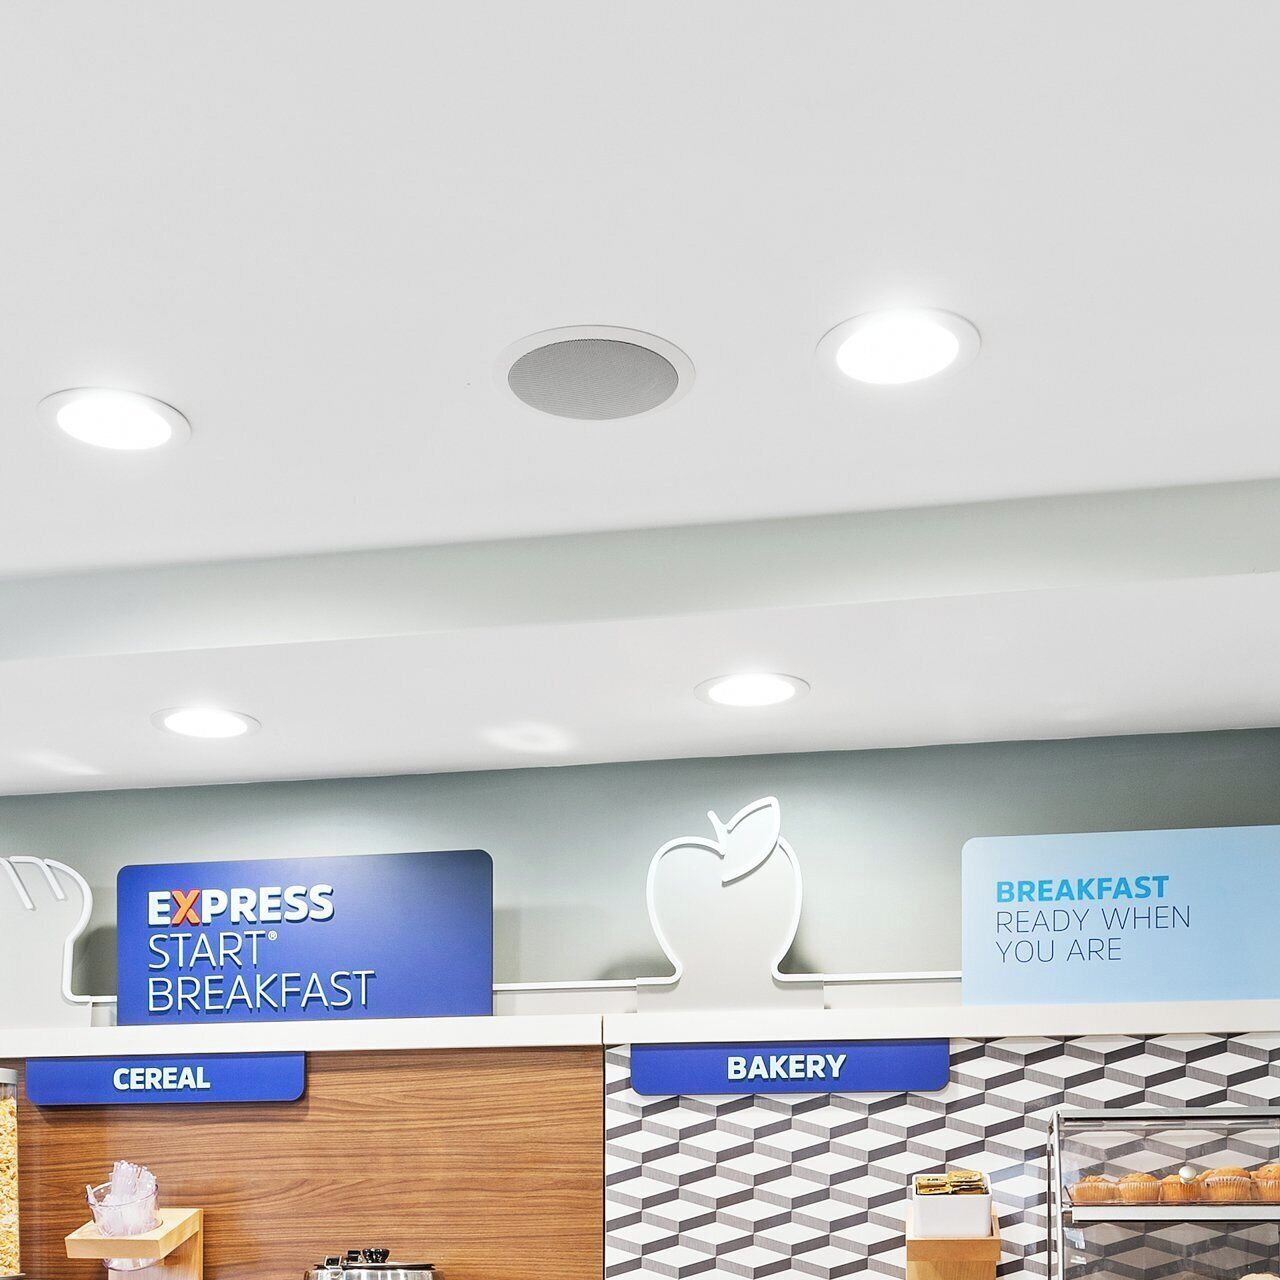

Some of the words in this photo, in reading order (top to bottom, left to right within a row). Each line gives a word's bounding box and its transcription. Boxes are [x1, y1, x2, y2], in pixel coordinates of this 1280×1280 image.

[996, 875, 1170, 903] BREAKFAST
[147, 884, 336, 926] EXPRESS
[996, 908, 1090, 934] READY
[1101, 905, 1190, 930] WHEN
[995, 939, 1054, 963] YOU
[1066, 937, 1122, 962] ARE
[148, 969, 376, 1012] BREAKFAST
[113, 1066, 211, 1090] CEREAL
[726, 1054, 847, 1080] BAKERY
